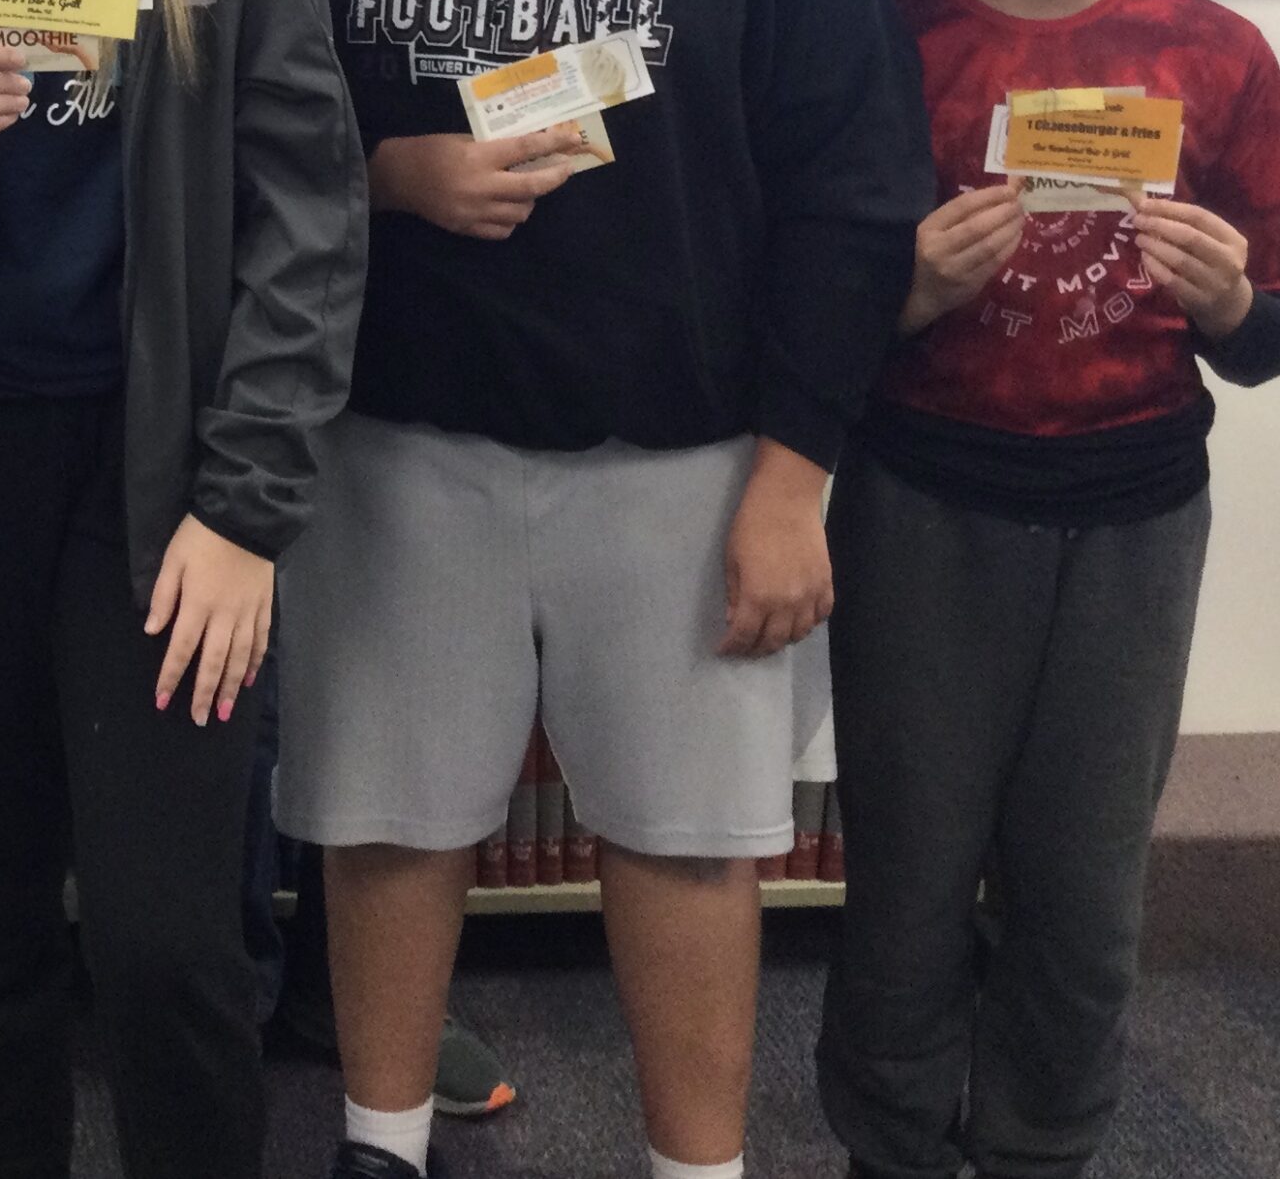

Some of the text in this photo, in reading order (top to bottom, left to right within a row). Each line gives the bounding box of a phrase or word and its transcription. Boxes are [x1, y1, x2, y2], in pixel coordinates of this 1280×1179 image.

[420, 59, 463, 74] SILVER
[1130, 126, 1161, 140] Fries
[1002, 269, 1037, 292] IT
